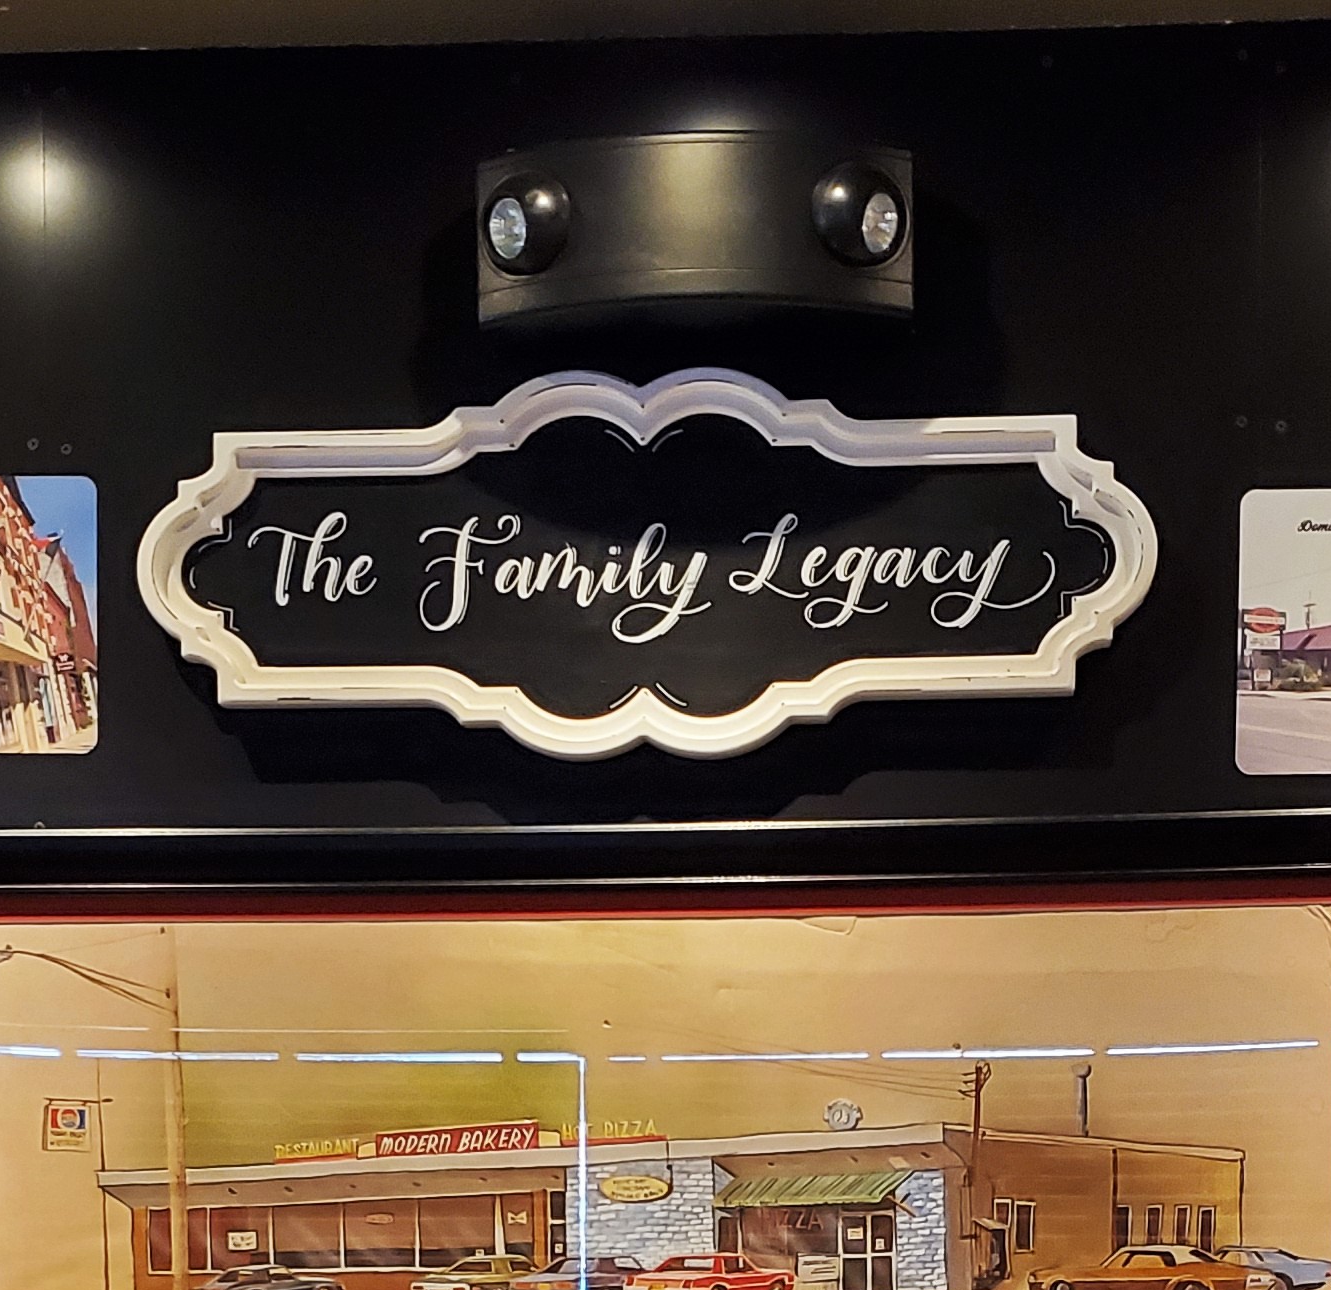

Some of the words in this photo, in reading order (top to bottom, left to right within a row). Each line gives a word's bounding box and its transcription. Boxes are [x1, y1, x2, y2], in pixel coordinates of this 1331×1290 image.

[248, 510, 377, 606] The
[418, 513, 711, 643] Family
[729, 511, 1056, 630] Legacy
[379, 1129, 452, 1155] MODERN
[458, 1126, 536, 1153] BAKERY
[604, 1119, 658, 1138] PIZZA
